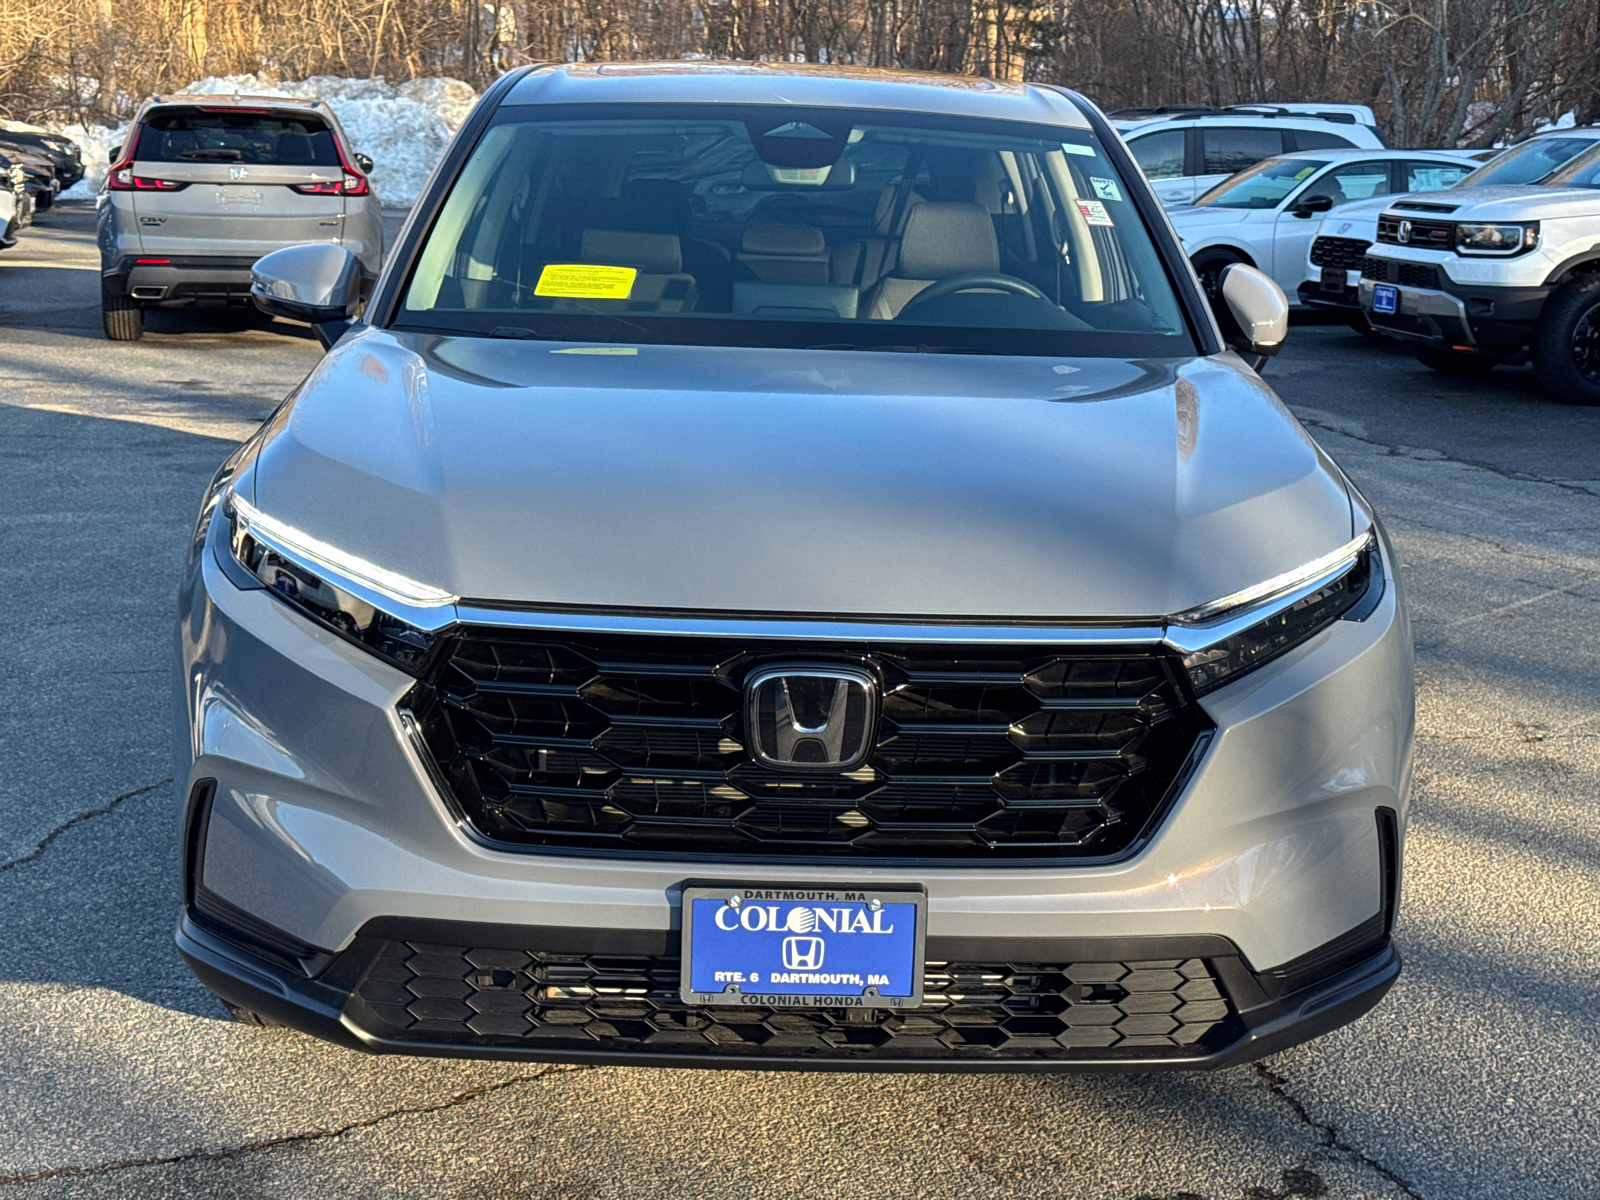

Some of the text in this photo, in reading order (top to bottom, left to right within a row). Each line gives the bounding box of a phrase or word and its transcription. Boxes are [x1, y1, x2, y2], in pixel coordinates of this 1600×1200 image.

[744, 890, 866, 902] DARTMOUTH, MA
[714, 905, 894, 934] COLONIAL
[714, 971, 890, 986] RTE. 6 DARTMOUTH, MA
[740, 994, 863, 1007] COLONIAL HONDA
